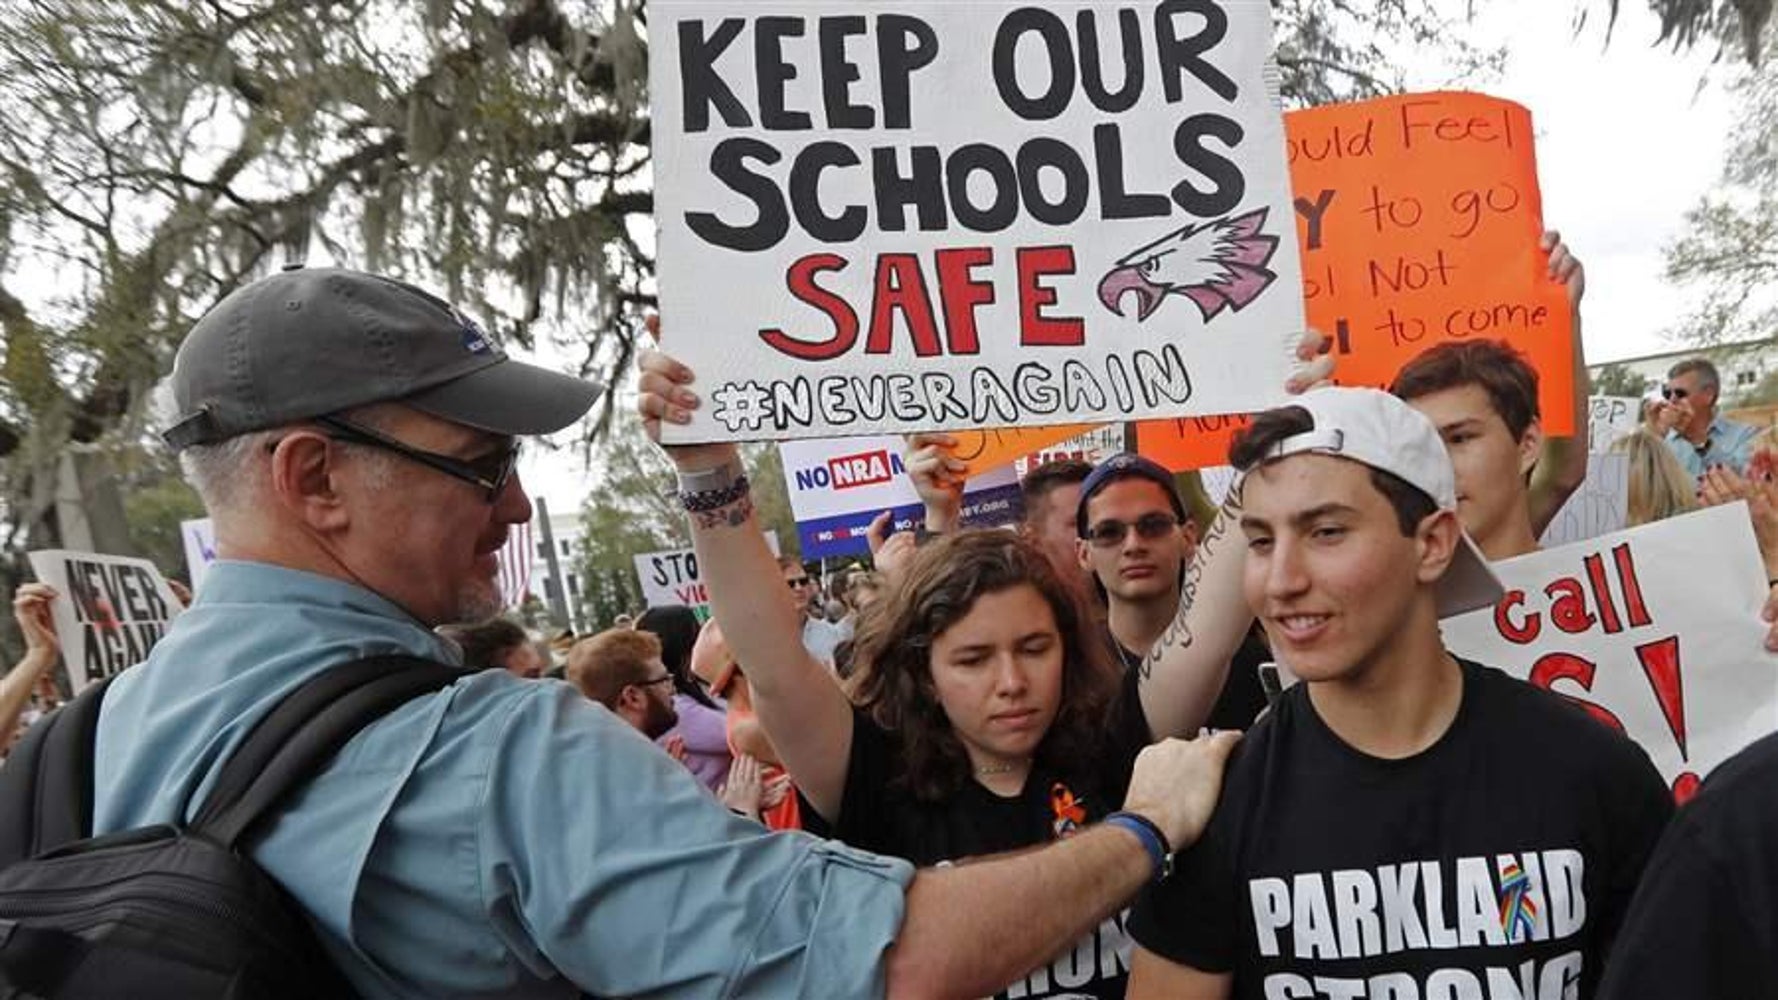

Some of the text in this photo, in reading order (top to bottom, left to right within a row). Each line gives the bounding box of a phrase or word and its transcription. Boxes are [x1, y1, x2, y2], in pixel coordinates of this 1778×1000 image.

[678, 0, 1238, 132] KEEP OUR
[1401, 100, 1513, 150] Feel
[684, 113, 1246, 252] SCHOOLS
[1361, 184, 1422, 232] to
[1450, 181, 1520, 239] go
[758, 244, 1086, 362] SAFE
[1369, 249, 1458, 297] Not
[1374, 309, 1426, 346] to
[1445, 302, 1548, 336] come
[712, 343, 1193, 432] #NEVERAGAIN
[795, 466, 830, 491] NO
[831, 454, 890, 486] NRA
[64, 558, 169, 623] NEVER
[651, 552, 698, 588] STO
[1494, 542, 1653, 645] call
[1248, 848, 1587, 960] PARKLAND
